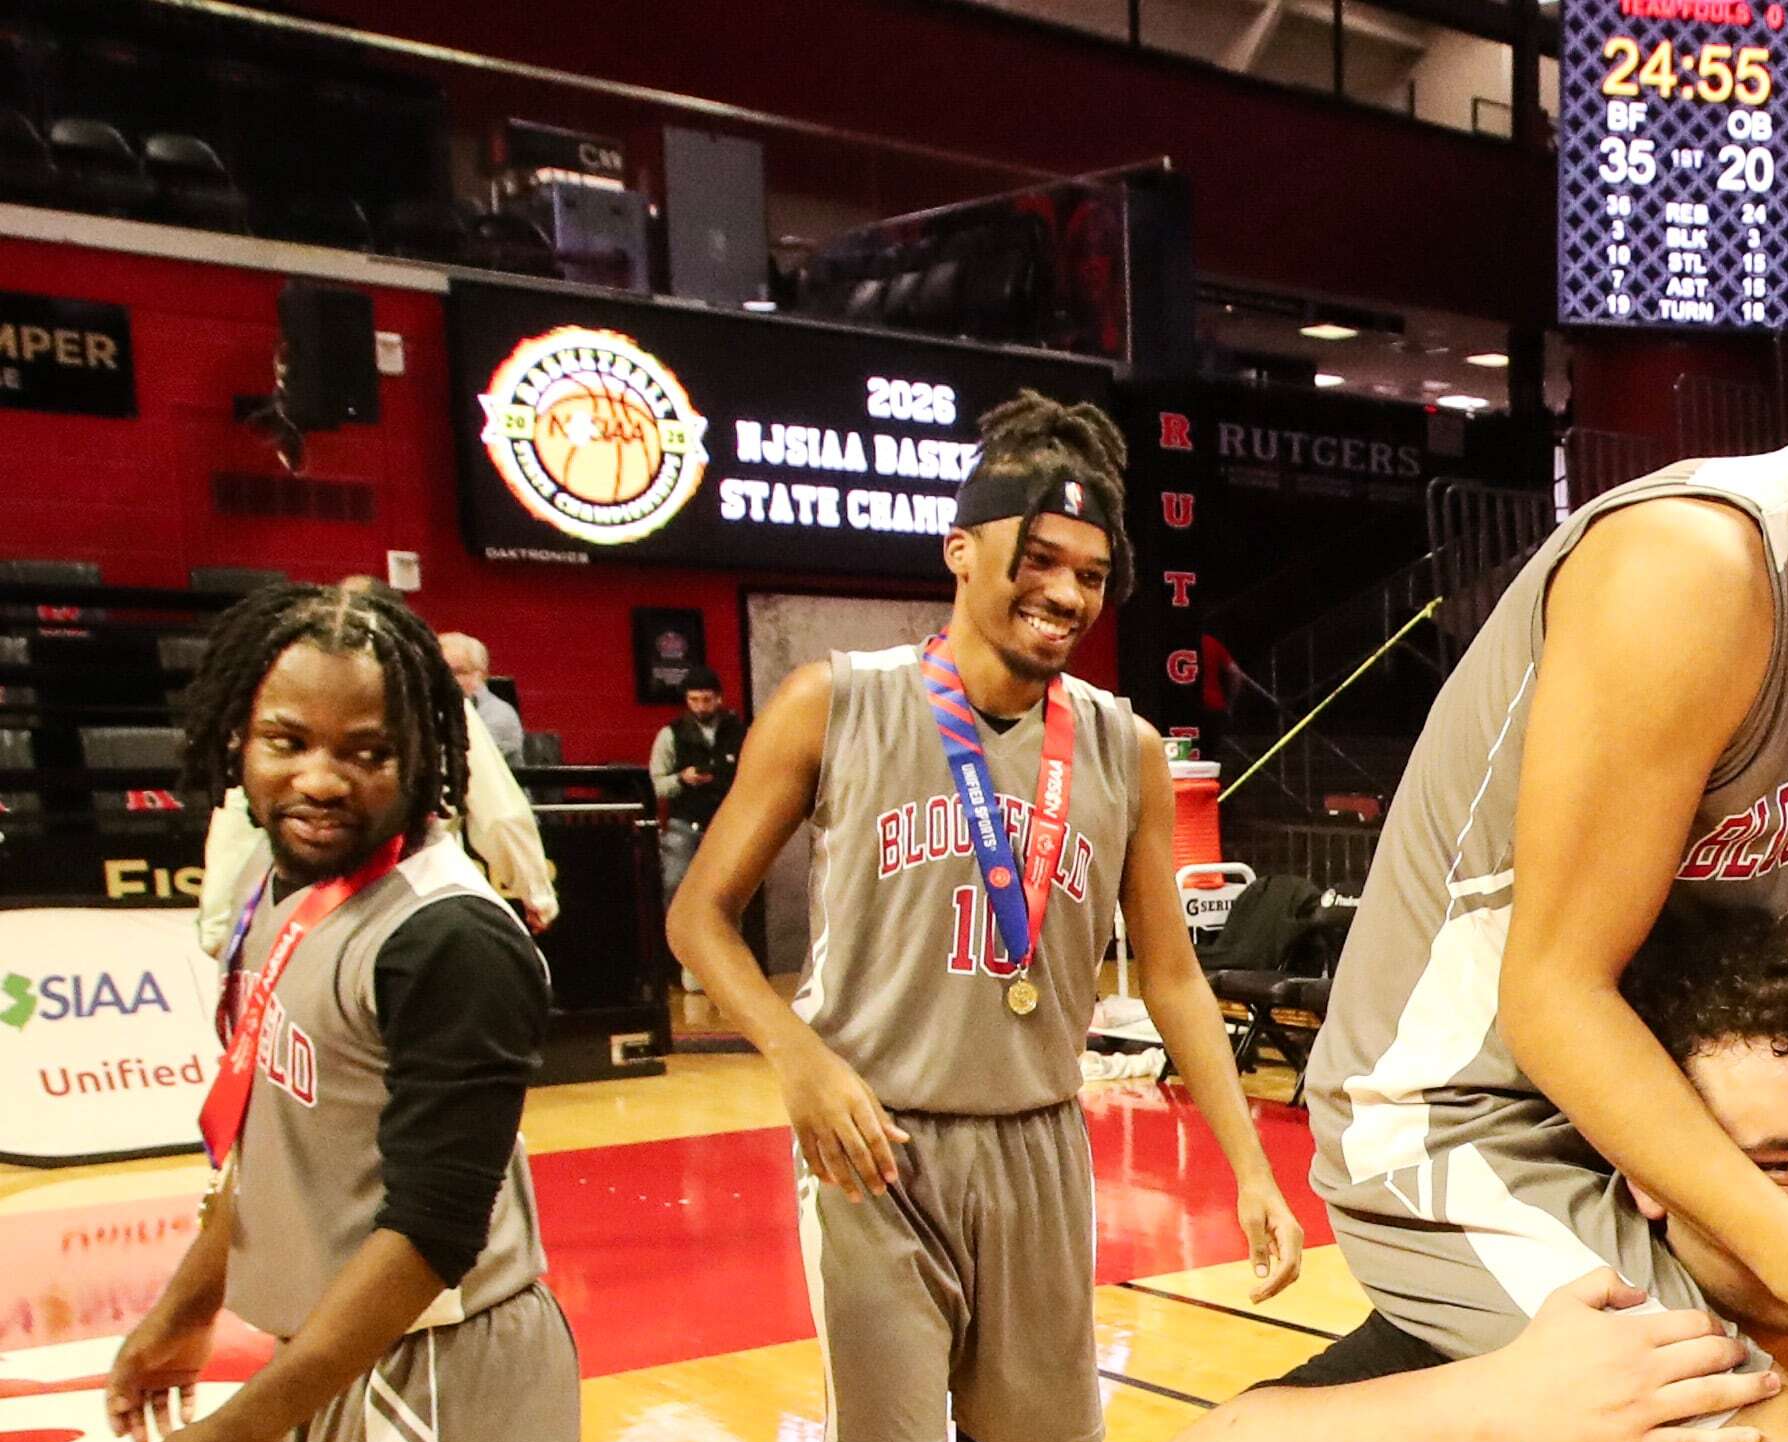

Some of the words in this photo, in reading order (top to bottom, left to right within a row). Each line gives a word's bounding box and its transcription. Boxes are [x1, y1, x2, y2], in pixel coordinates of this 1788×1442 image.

[1602, 36, 1771, 105] 24:55
[1607, 101, 1647, 132] BF
[1727, 110, 1773, 141] OB
[1599, 136, 1656, 185] 35
[1671, 149, 1703, 168] 1ST
[1717, 144, 1774, 192] 20
[1666, 227, 1708, 249] BLK
[1612, 269, 1625, 288] 7
[1666, 277, 1709, 298] AST
[1668, 252, 1707, 274] STL
[1659, 299, 1714, 322] TURN
[866, 376, 957, 425] 2026
[735, 419, 868, 473] NJSIAA
[1218, 421, 1421, 477] RUTGERS
[719, 477, 841, 528] STATE
[974, 804, 999, 850] SPORTS
[38, 1055, 205, 1097] Unified
